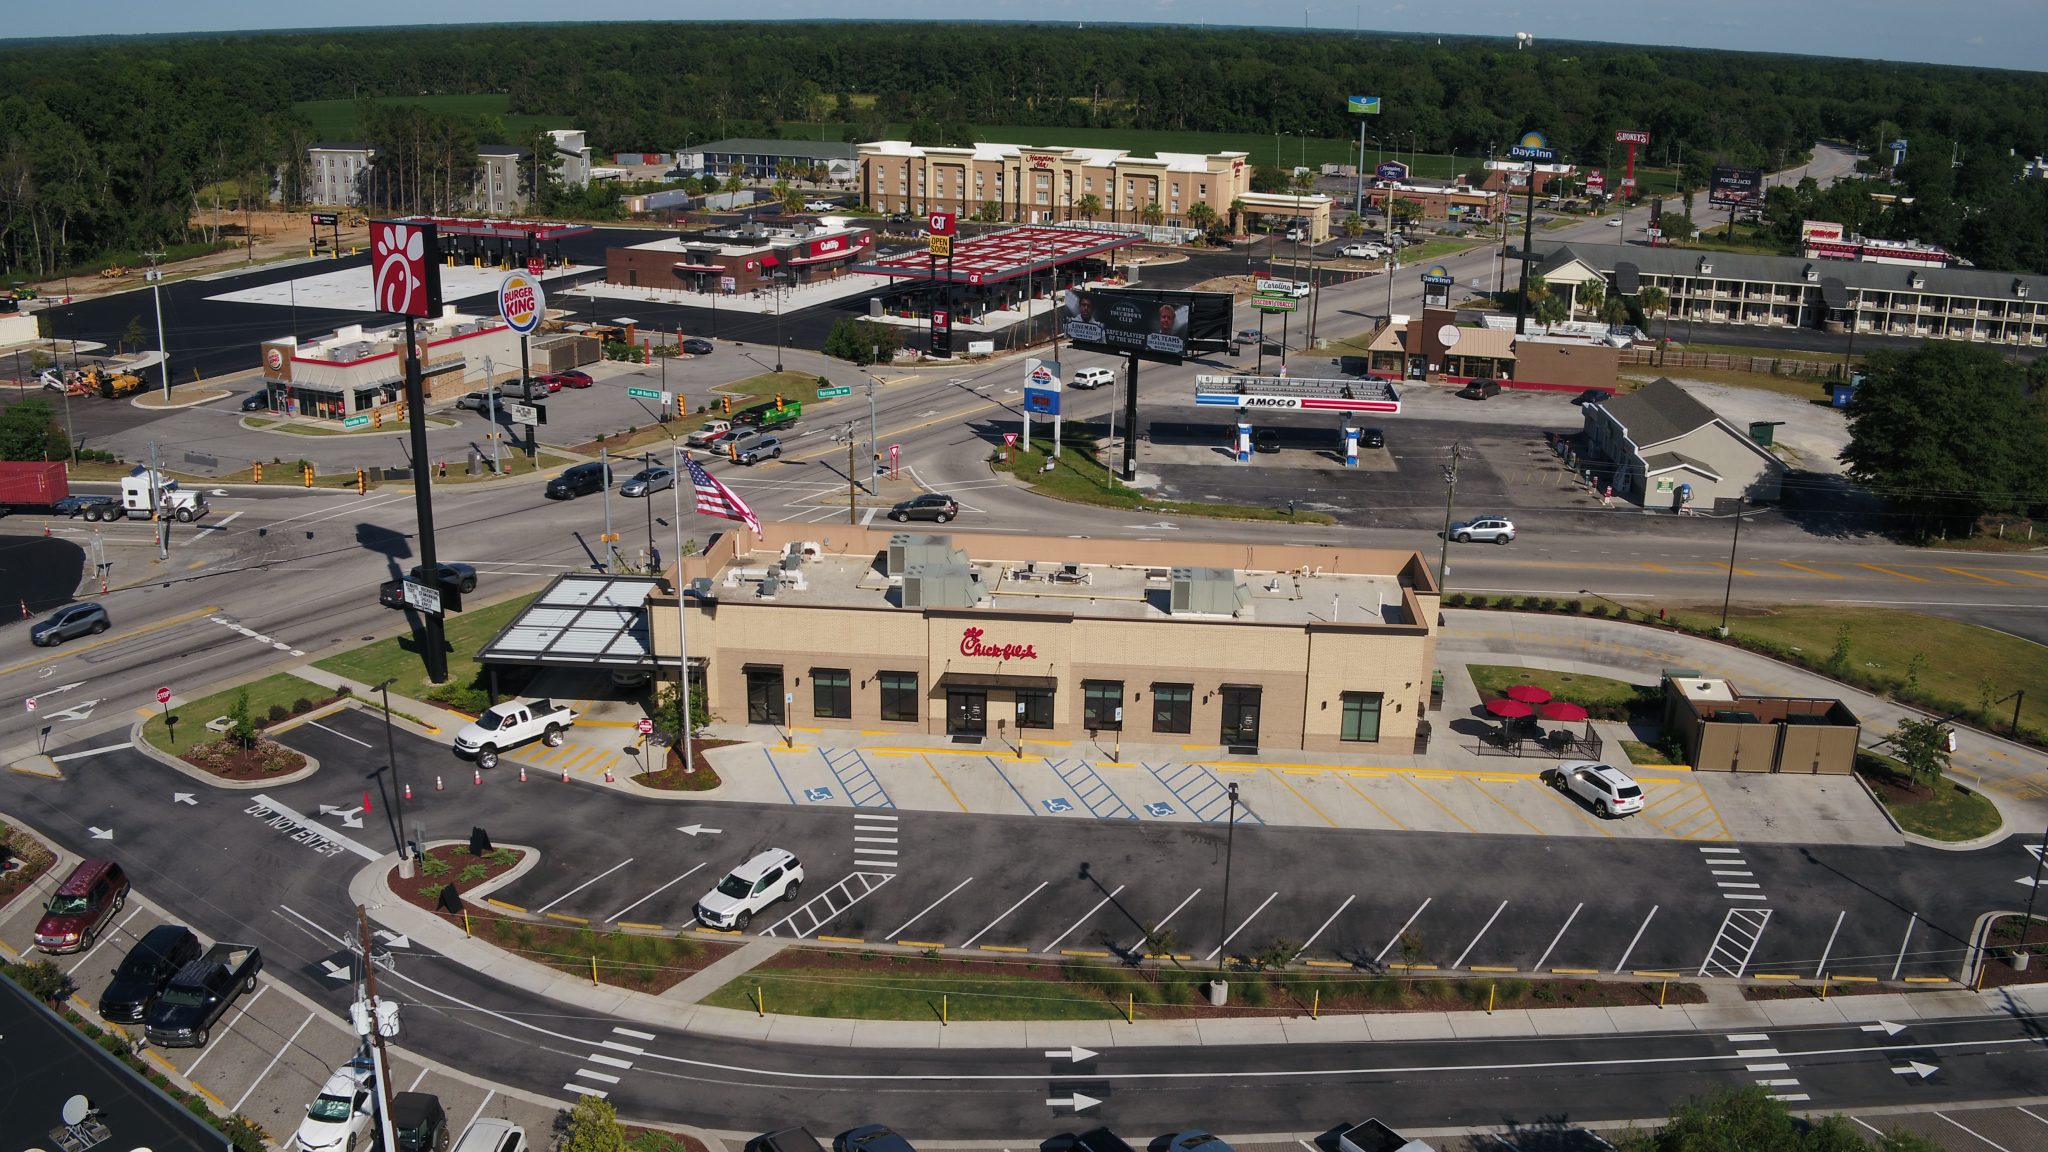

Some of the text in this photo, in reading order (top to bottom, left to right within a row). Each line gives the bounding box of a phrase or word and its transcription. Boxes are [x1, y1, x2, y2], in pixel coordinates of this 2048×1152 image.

[1617, 133, 1646, 143] SHONEY'S
[1512, 147, 1552, 158] Days Inn
[931, 216, 946, 230] QT
[821, 240, 839, 250] QuikTrip
[931, 237, 948, 246] OPEN
[930, 245, 948, 254] SOON
[970, 274, 979, 282] QT
[1264, 281, 1291, 290] Carolina
[504, 287, 533, 303] BURGER
[506, 297, 535, 318] KING
[934, 314, 944, 324] QT
[1072, 323, 1097, 332] LINEMAN
[1246, 398, 1296, 407] AMOCO
[960, 627, 1037, 660] Chick-fil-A
[157, 690, 170, 700] STOP
[243, 803, 344, 858] DO NOT ENTER
